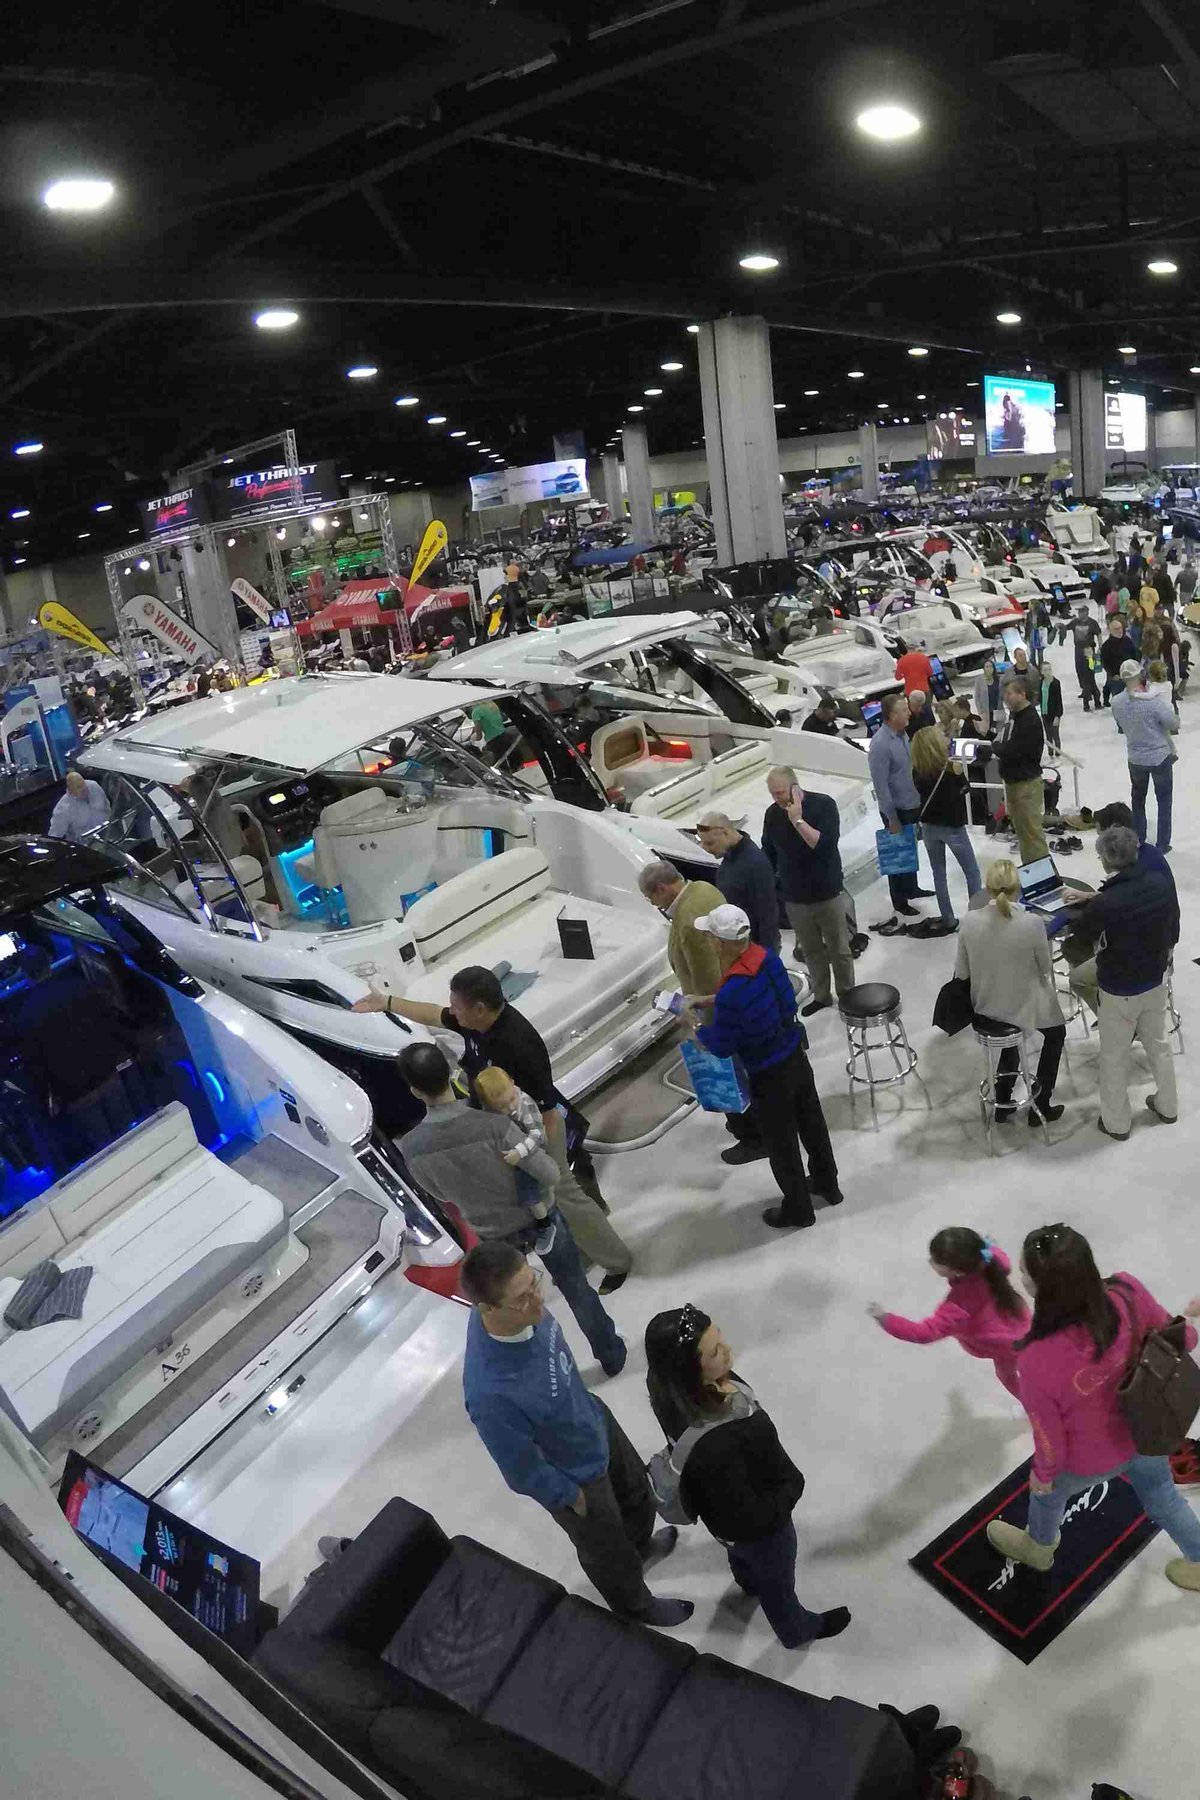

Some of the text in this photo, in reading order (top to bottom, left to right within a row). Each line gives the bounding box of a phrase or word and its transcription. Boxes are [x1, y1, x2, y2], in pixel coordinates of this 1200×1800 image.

[227, 473, 254, 489] JET
[147, 498, 162, 512] JET
[153, 610, 198, 656] YAMAHA
